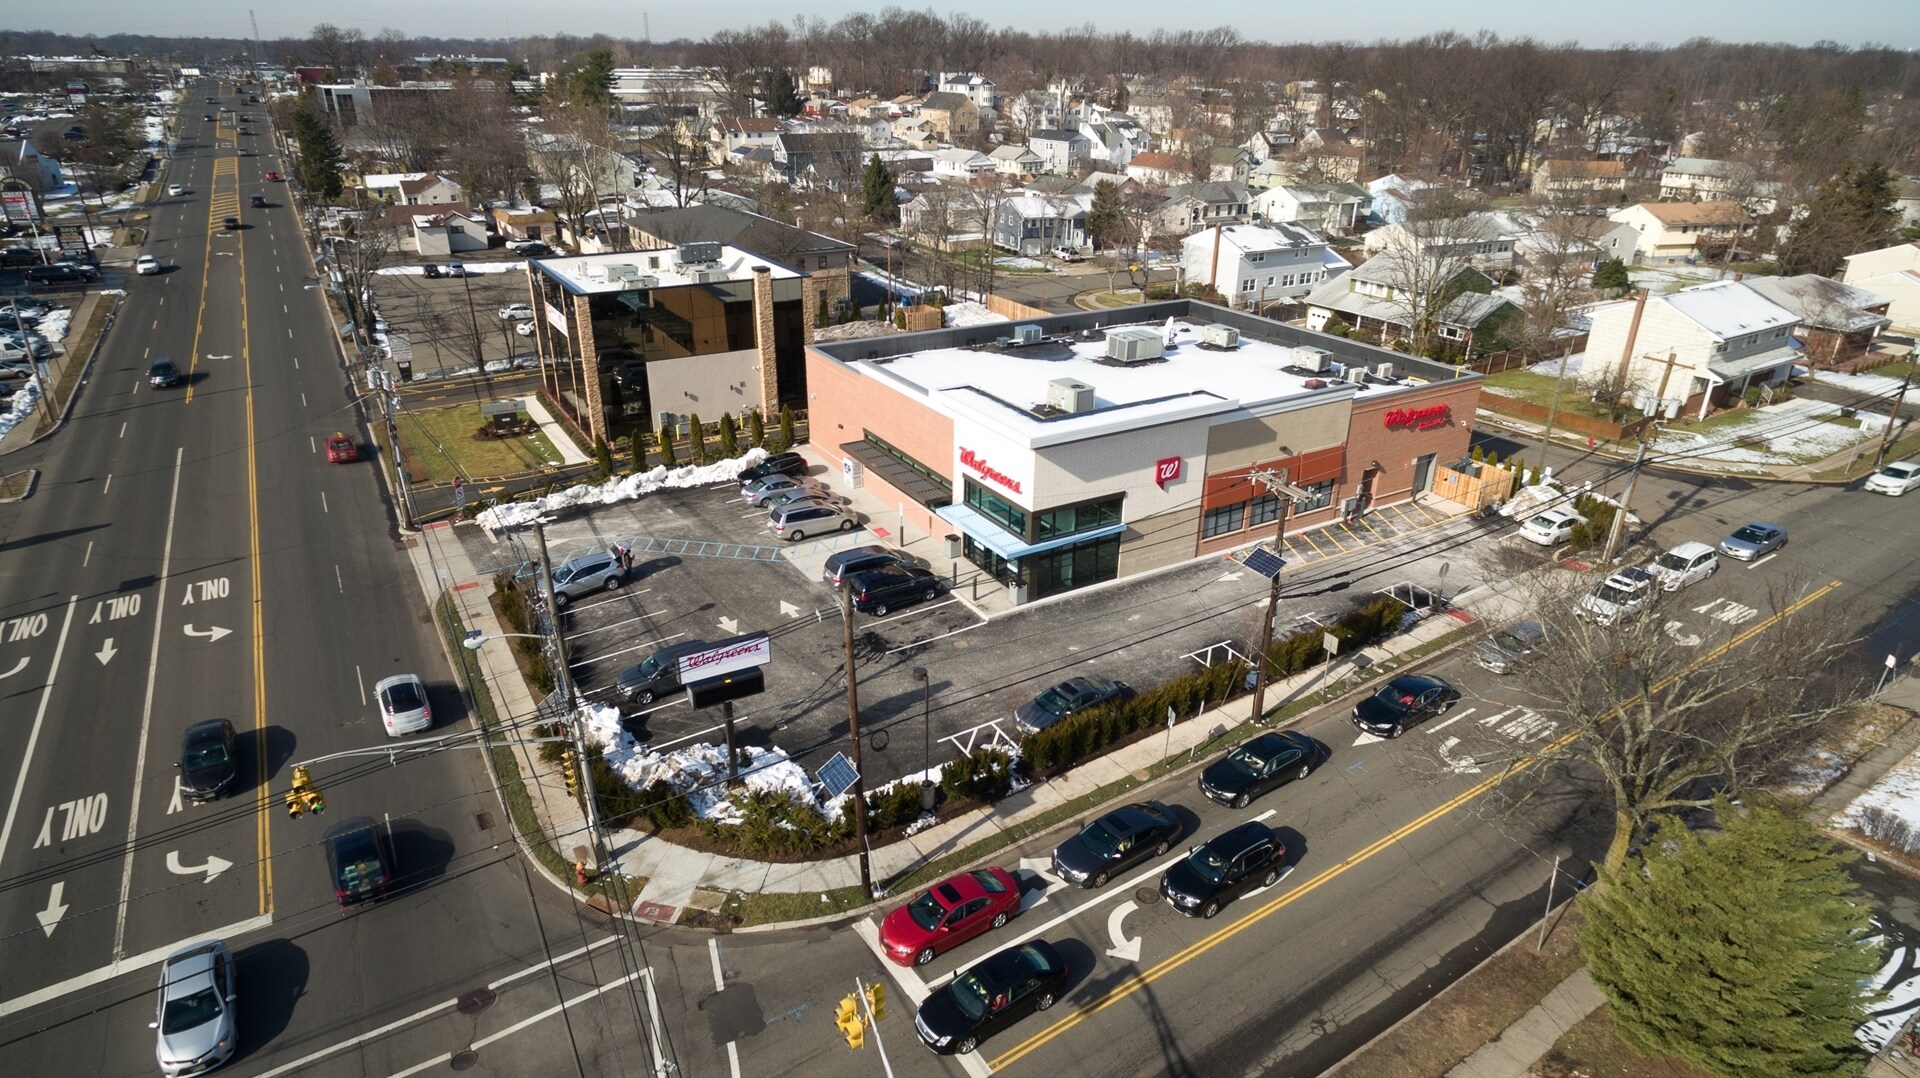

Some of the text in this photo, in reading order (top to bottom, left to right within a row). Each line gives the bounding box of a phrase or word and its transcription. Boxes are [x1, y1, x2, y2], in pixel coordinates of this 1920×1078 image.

[959, 446, 1022, 494] Walgreens
[182, 577, 230, 605] ONLY
[89, 594, 141, 624] ONLY
[1691, 598, 1758, 625] ONLY
[687, 643, 761, 666] Walgreens
[1479, 705, 1559, 744] ONLY
[33, 792, 108, 849] ONLY
